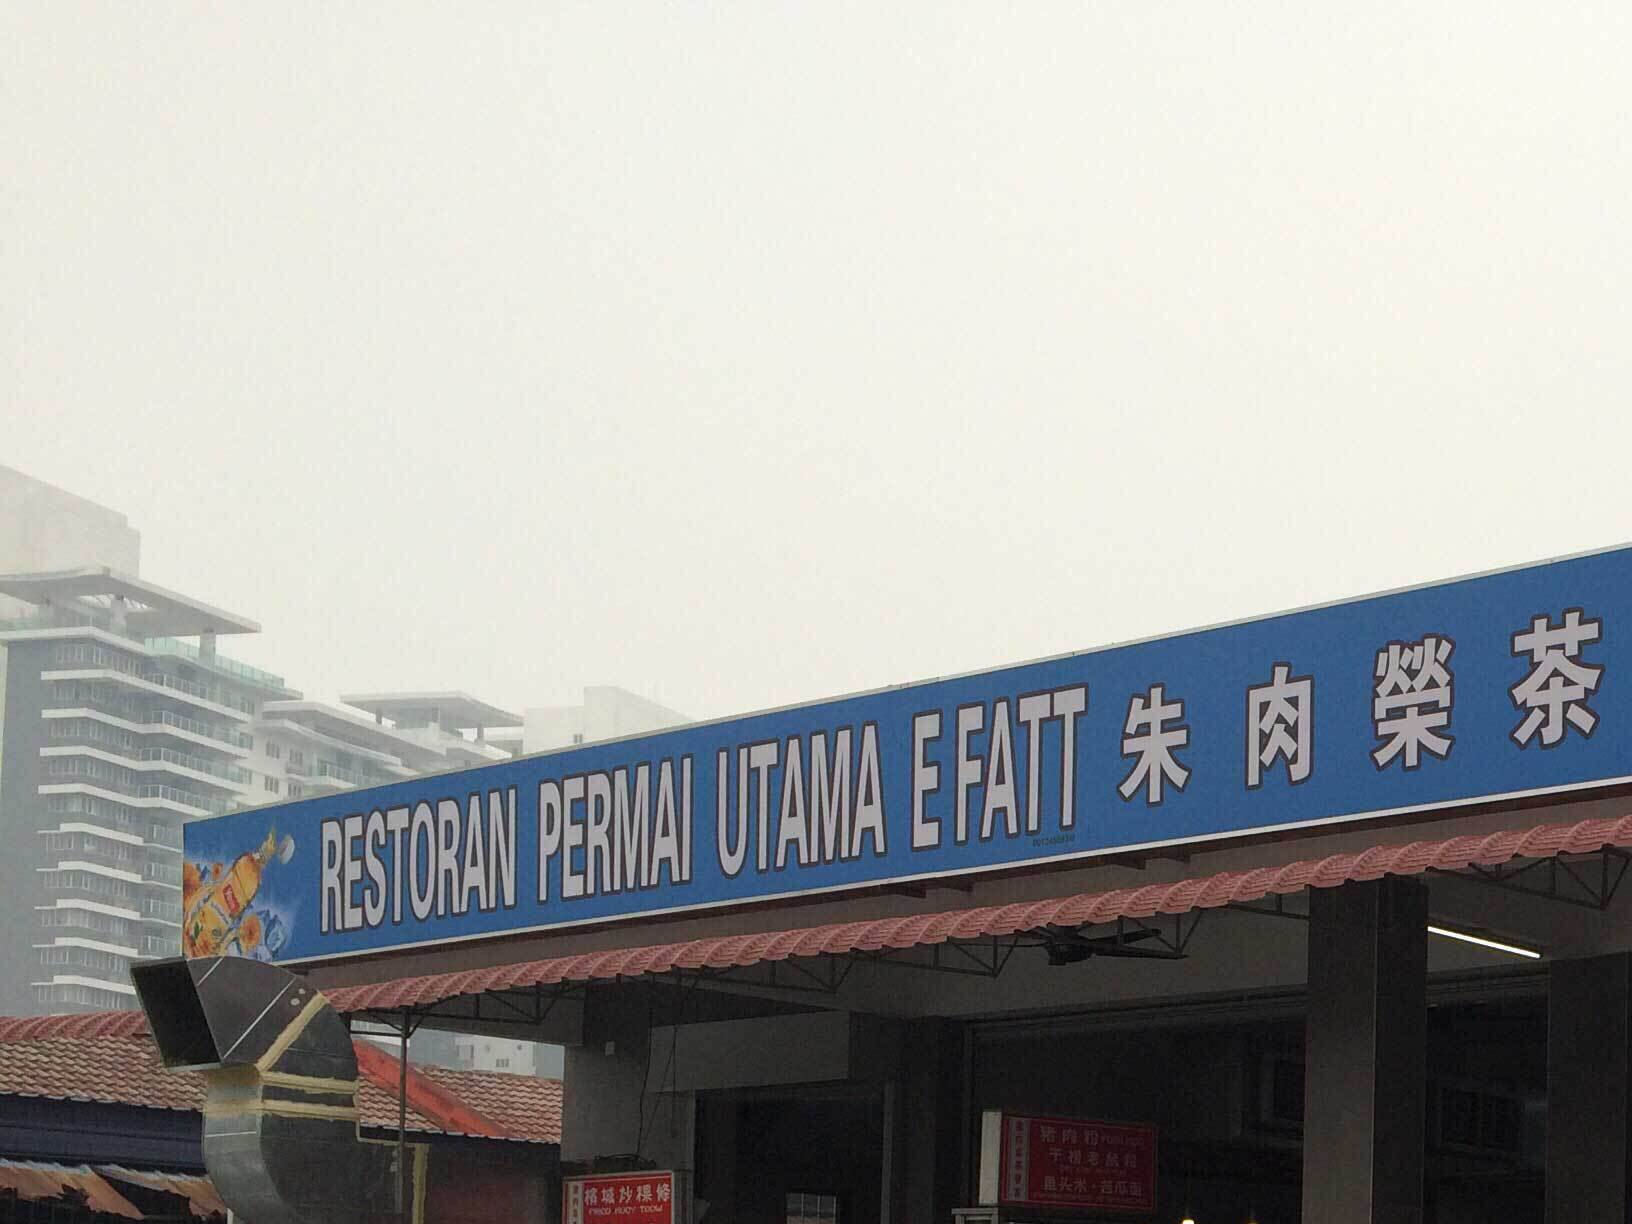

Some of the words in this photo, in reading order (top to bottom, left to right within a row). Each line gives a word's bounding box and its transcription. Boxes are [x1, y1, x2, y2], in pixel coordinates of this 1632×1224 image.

[319, 788, 518, 935] RESTORAN
[537, 756, 694, 903] PERMAI
[717, 722, 887, 876] UTAMA
